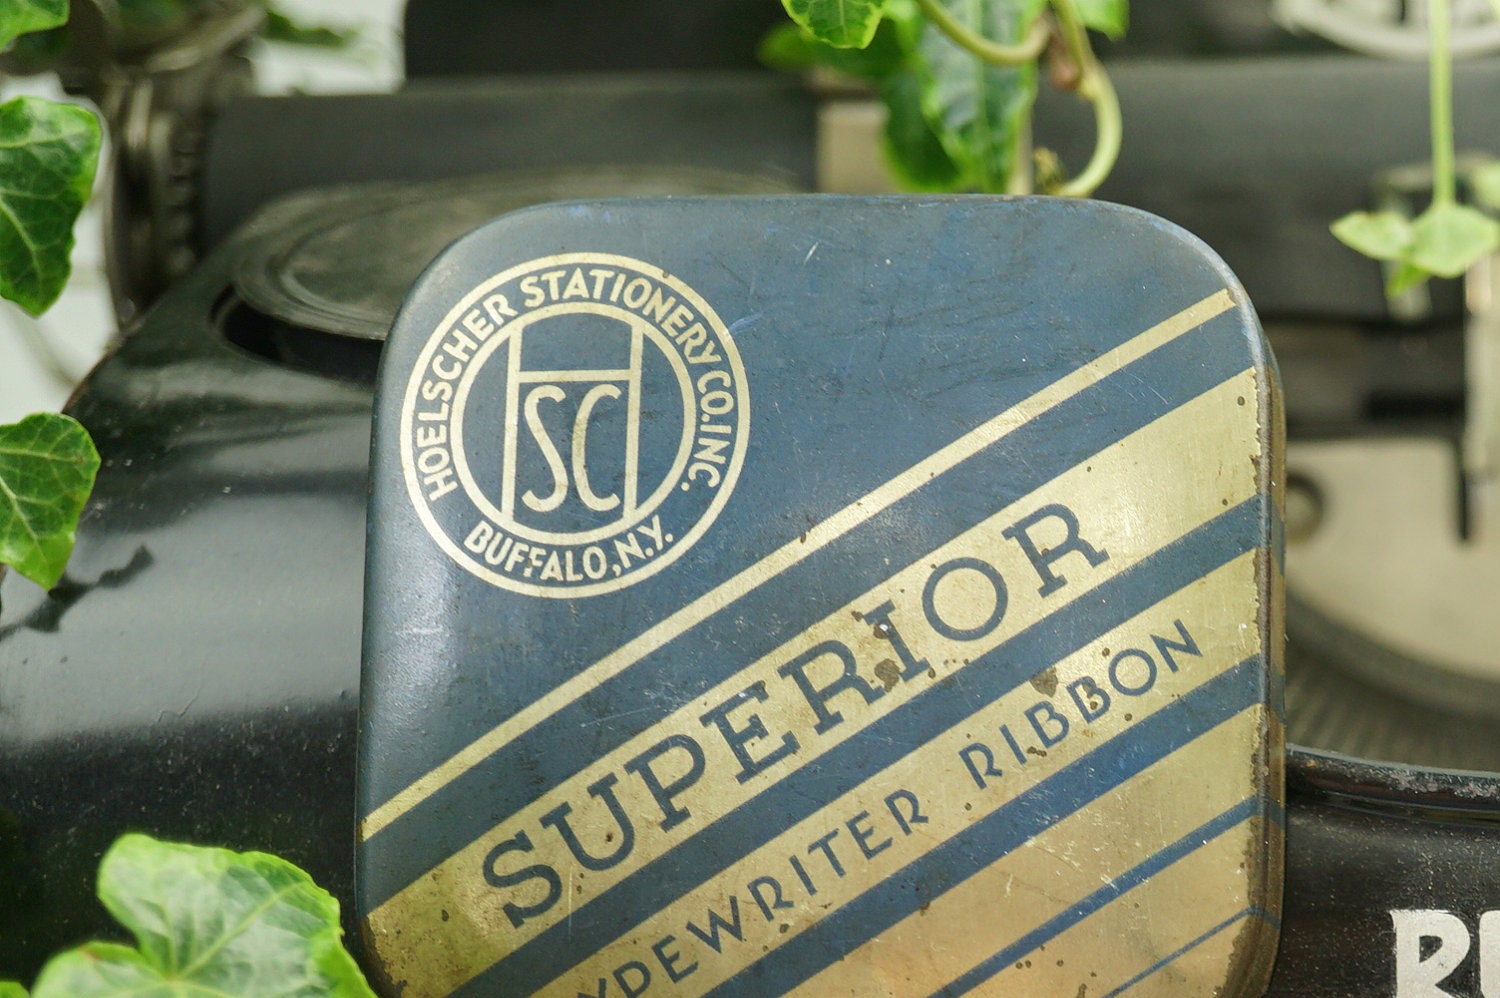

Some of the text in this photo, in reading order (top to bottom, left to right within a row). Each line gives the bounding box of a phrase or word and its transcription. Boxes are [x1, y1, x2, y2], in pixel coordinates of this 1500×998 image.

[416, 293, 519, 503] HOELSCHER
[519, 266, 723, 366] STATIONERY
[481, 503, 1112, 931] SUPERIOR
[958, 619, 1205, 790] RIBBON
